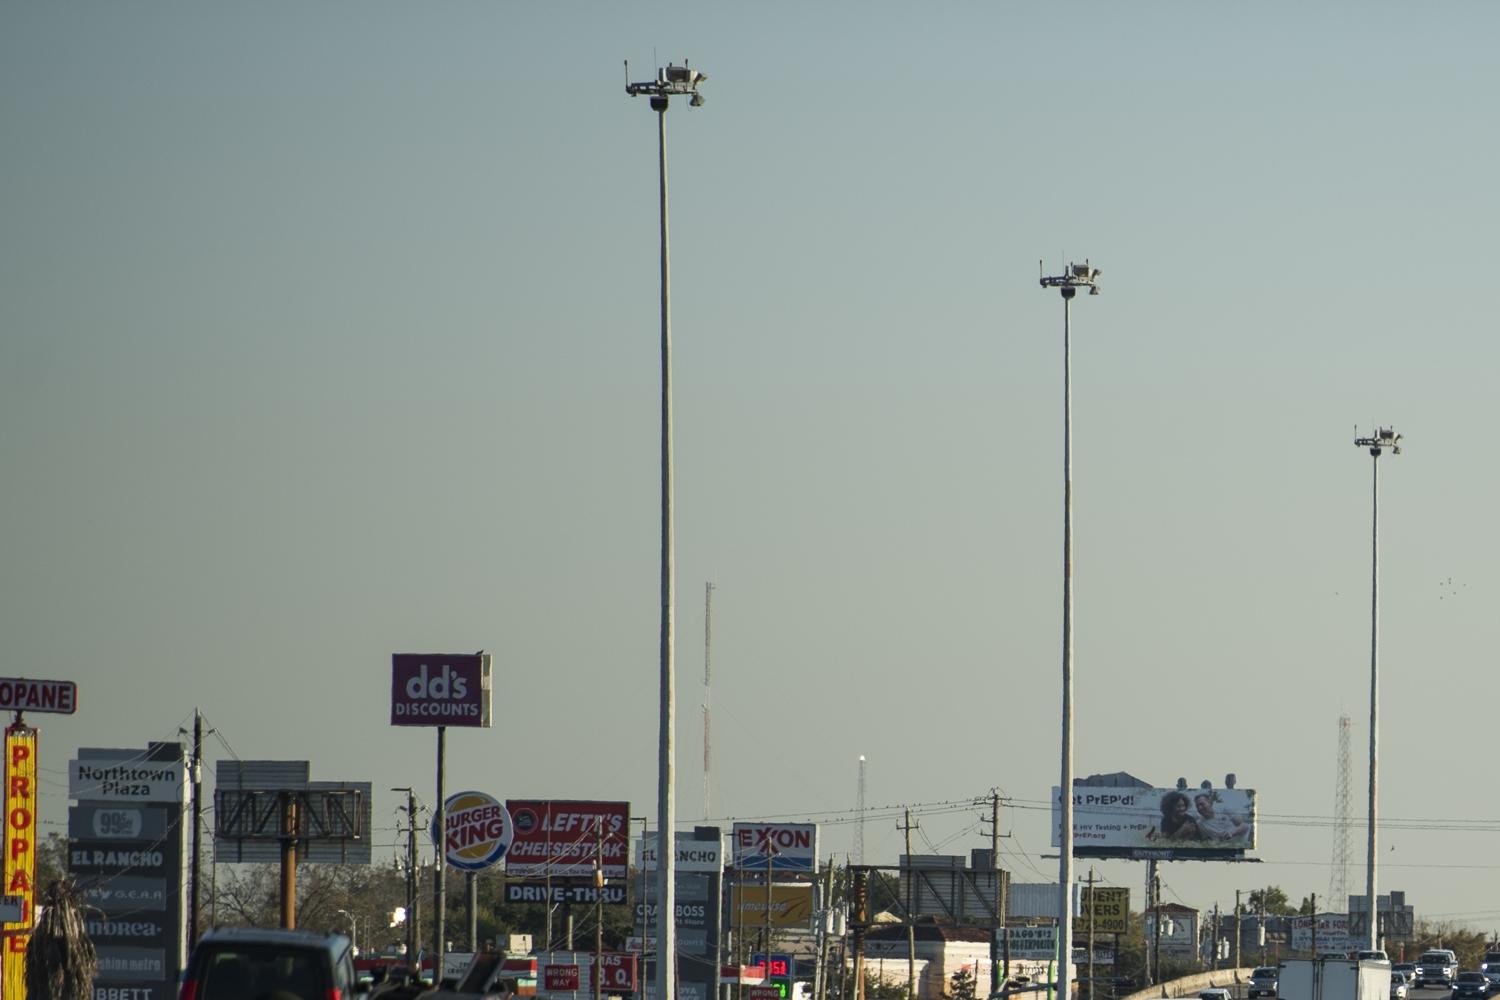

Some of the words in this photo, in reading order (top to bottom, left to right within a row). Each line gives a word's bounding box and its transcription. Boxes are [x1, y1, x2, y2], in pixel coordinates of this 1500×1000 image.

[406, 665, 467, 699] dd's
[396, 702, 479, 717] DISCOUNTS
[78, 766, 175, 781] Northtown
[103, 782, 150, 795] Plaza
[446, 820, 503, 850] KING
[738, 829, 810, 854] EXXON
[72, 851, 91, 865] EL
[97, 851, 163, 867] RANCHO
[510, 886, 622, 901] DRIVE-THRU
[676, 906, 704, 918] BOSS
[547, 967, 577, 977] WRONG
[552, 978, 571, 987] WAY
